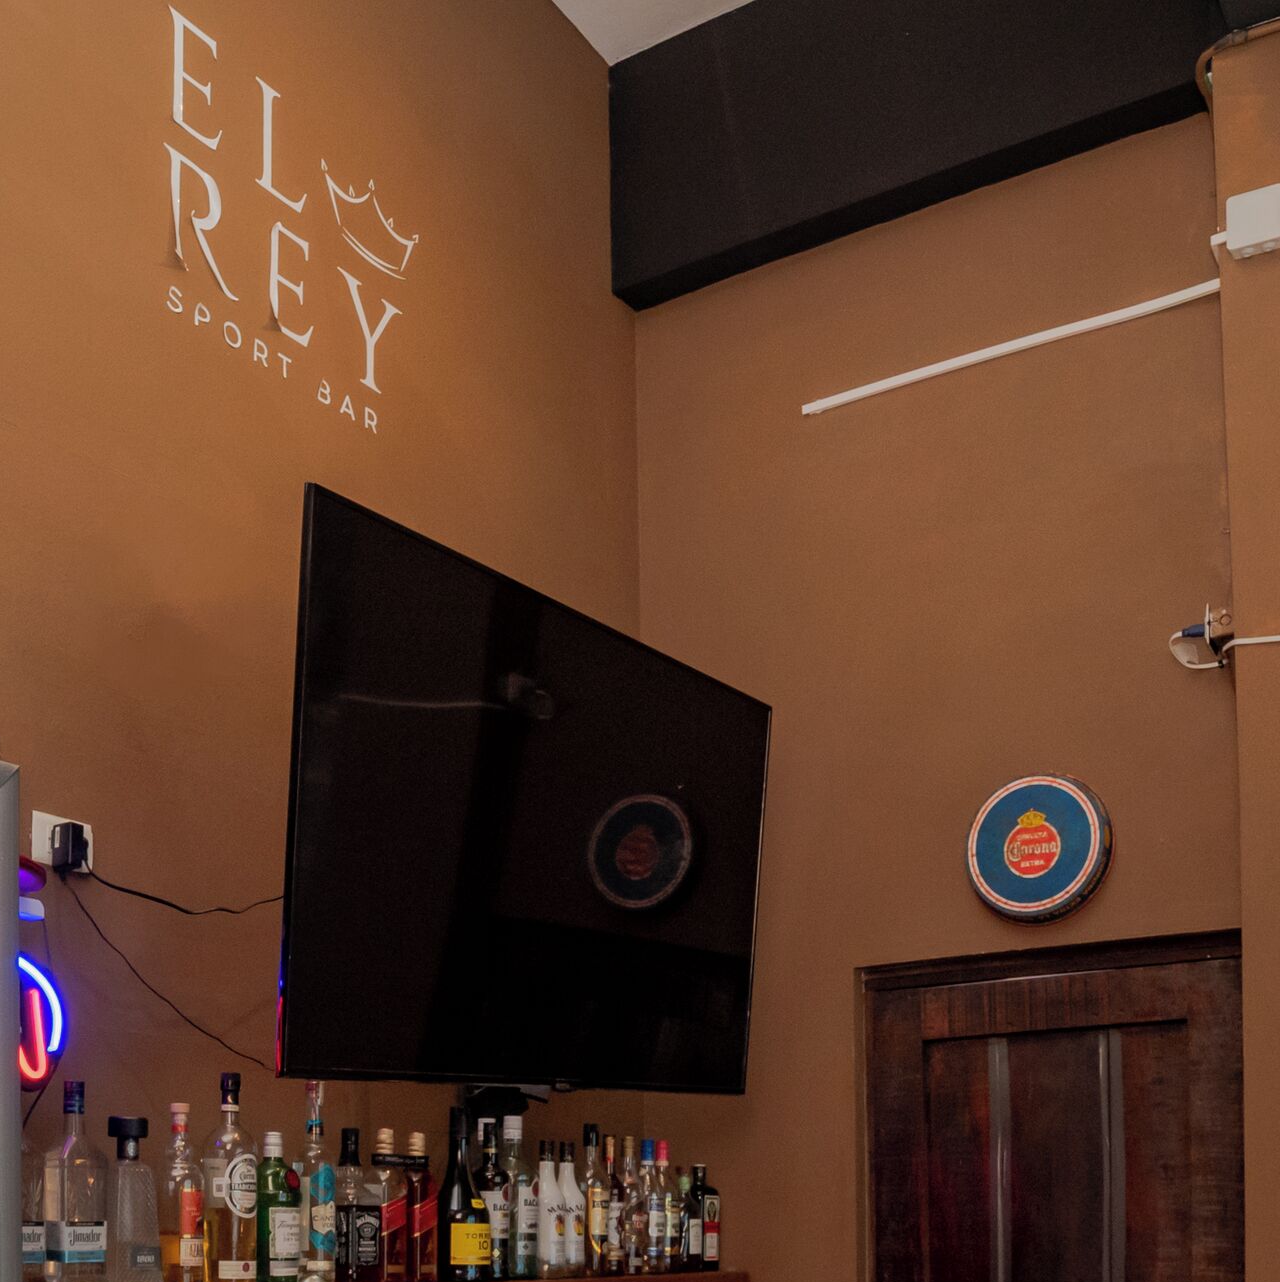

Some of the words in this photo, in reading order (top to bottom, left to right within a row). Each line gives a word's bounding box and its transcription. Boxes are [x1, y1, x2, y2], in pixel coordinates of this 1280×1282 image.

[169, 5, 307, 213] EL
[164, 142, 403, 394] REY
[167, 286, 292, 378] SPORT
[317, 380, 378, 433] BAR
[1008, 840, 1057, 862] Corona
[478, 1240, 489, 1250] 10
